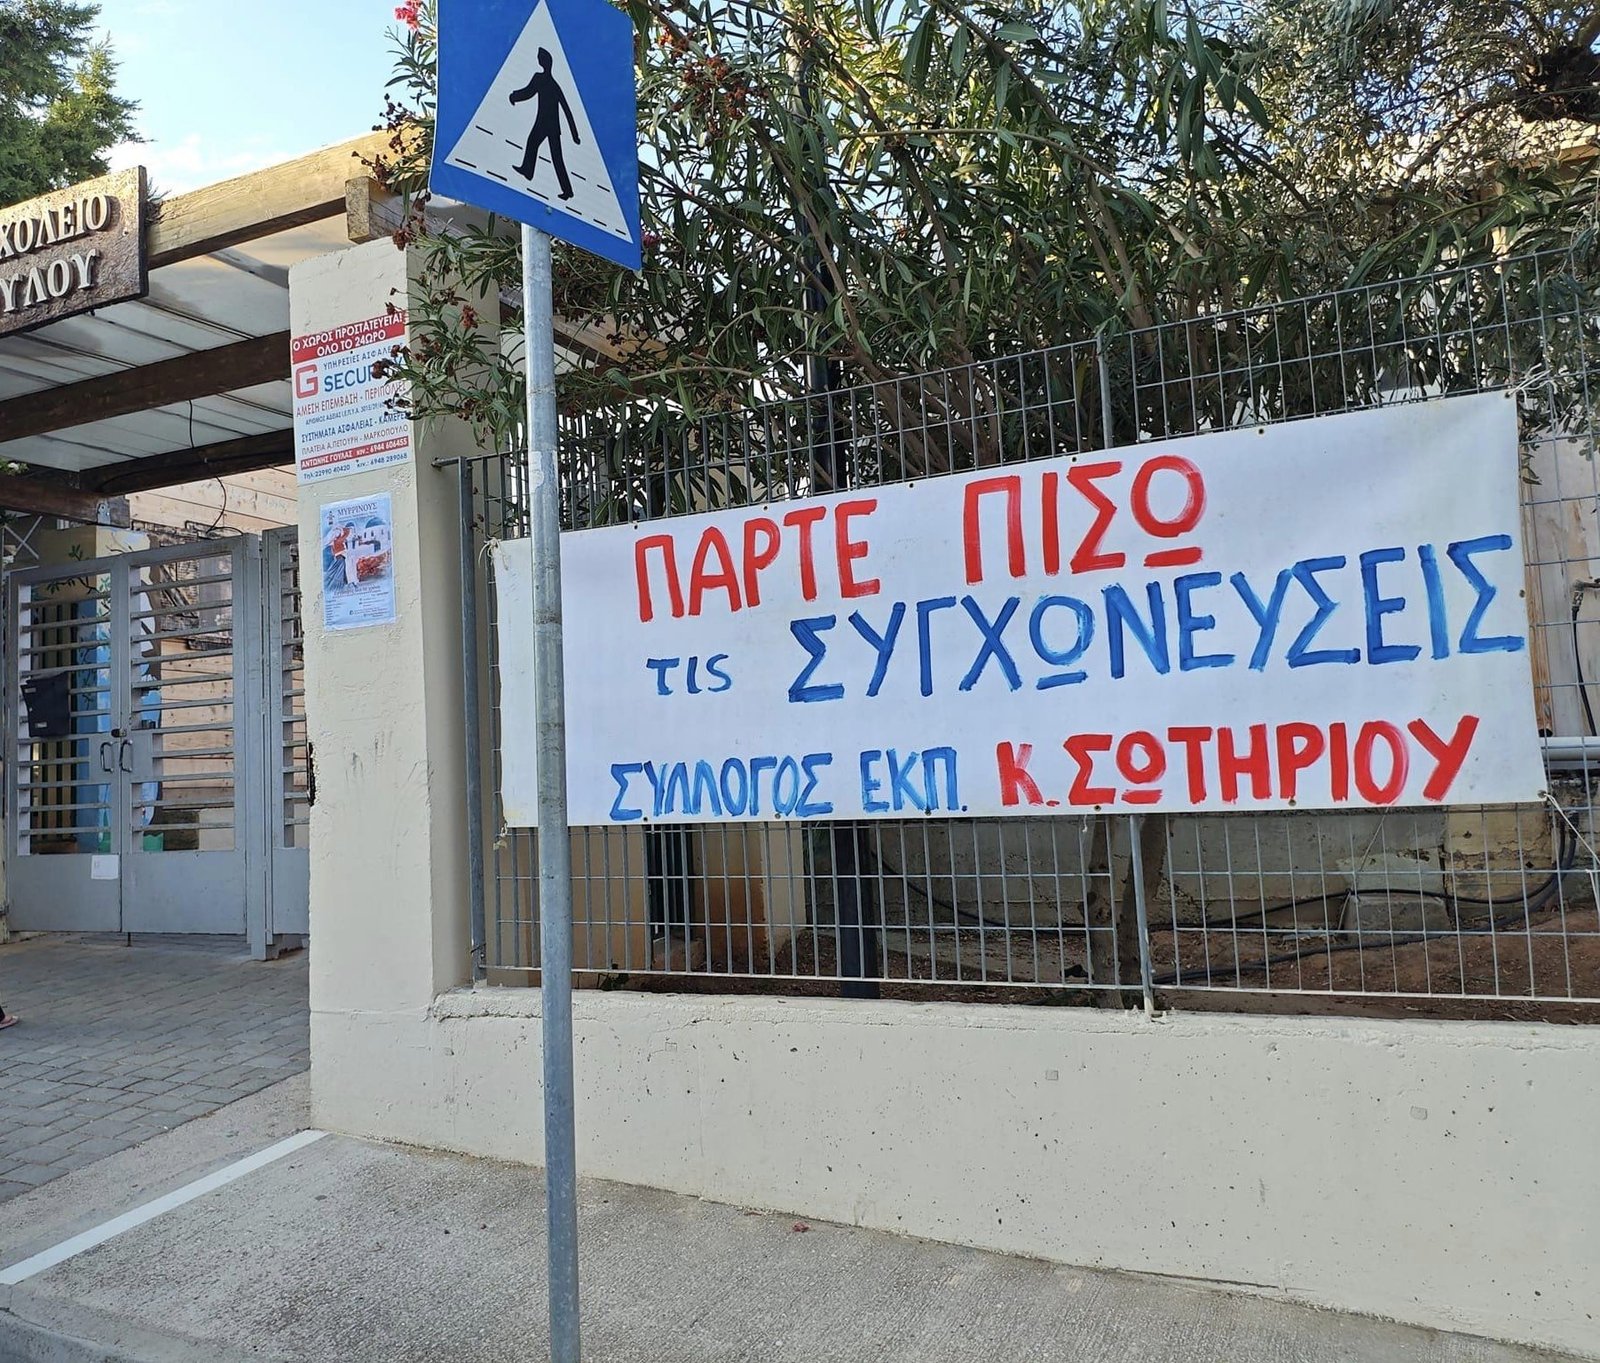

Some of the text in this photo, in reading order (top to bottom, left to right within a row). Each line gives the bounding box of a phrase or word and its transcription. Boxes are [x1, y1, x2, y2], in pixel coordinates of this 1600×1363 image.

[293, 341, 301, 351] Ο
[302, 331, 334, 349] ΧΩΡΟΣ
[316, 330, 386, 357] ΟΛΟ ΤΟ 24ΩΡΟ
[295, 364, 319, 399] G
[296, 401, 320, 417] ΑΜΕΣΗ
[321, 393, 358, 411] ΕΠΕΜΒΑΣΗ
[301, 427, 336, 443] ΣΥΣΤΗΜΑΤΑ
[337, 418, 373, 434] ΑΣΦΑΛΕΙΑΣ
[363, 424, 408, 441] ΜΑΡΚΟΠΟΥΛΟ
[636, 455, 1206, 622] ΠΑΡΤΕ ΠΙΣΩ
[788, 533, 1526, 704] ΣΥΓΧΩΝΕΥΣΕΙΣ
[609, 752, 834, 822] ΣΥΛΛΟΓΟΣ
[859, 746, 968, 815] ΕΚΠ.
